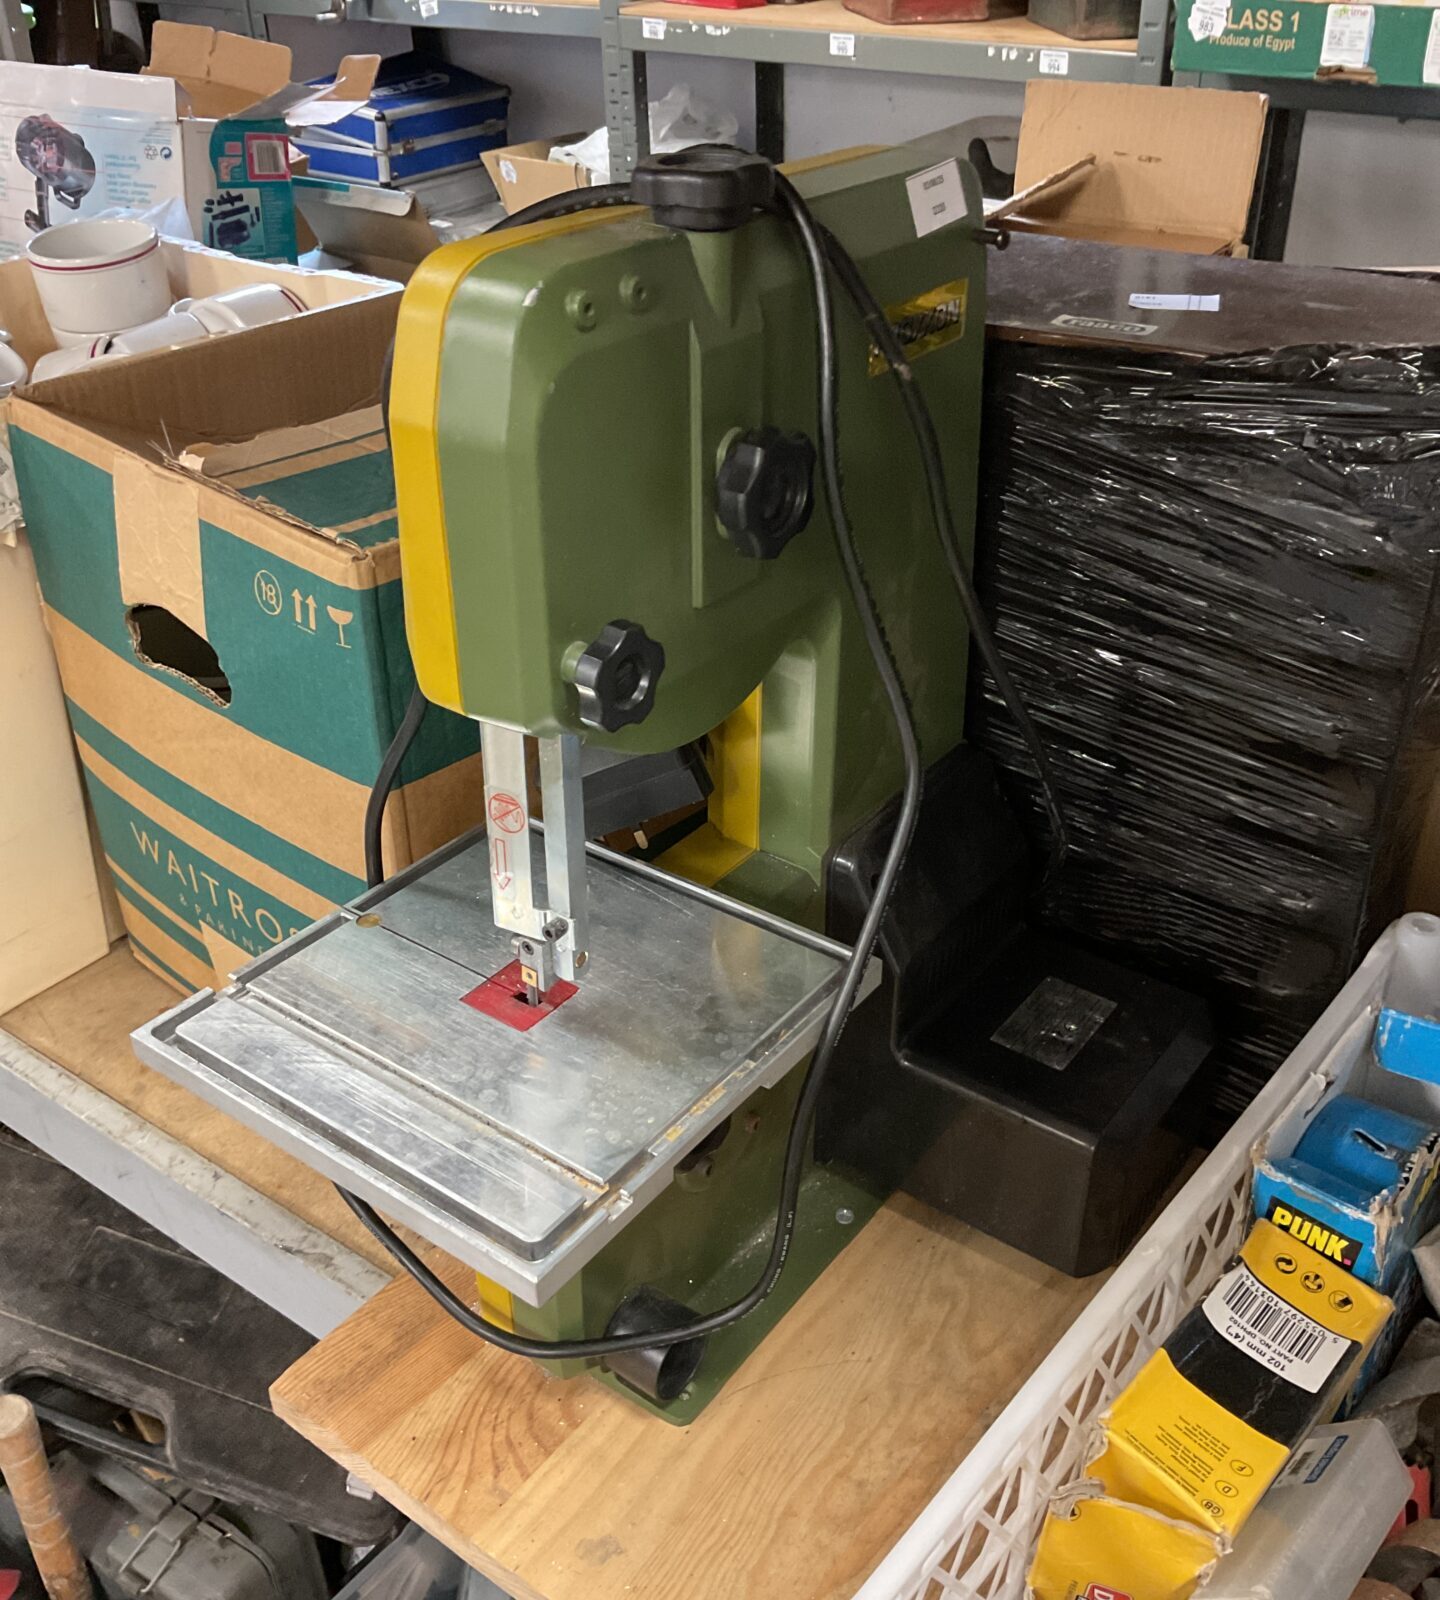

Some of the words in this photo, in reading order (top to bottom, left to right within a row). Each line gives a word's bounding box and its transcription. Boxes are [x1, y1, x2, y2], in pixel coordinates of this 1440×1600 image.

[1227, 8, 1283, 32] LASS
[1290, 11, 1300, 33] 1
[1252, 34, 1265, 48] of
[1265, 35, 1296, 53] Egypt
[130, 821, 299, 944] WAITRO
[1284, 1309, 1326, 1338] 055297
[1246, 1340, 1267, 1358] mm
[1272, 1347, 1294, 1364] PART
[1267, 1356, 1286, 1372] 102
[1222, 1485, 1232, 1494] D
[1204, 1501, 1221, 1515] GB
